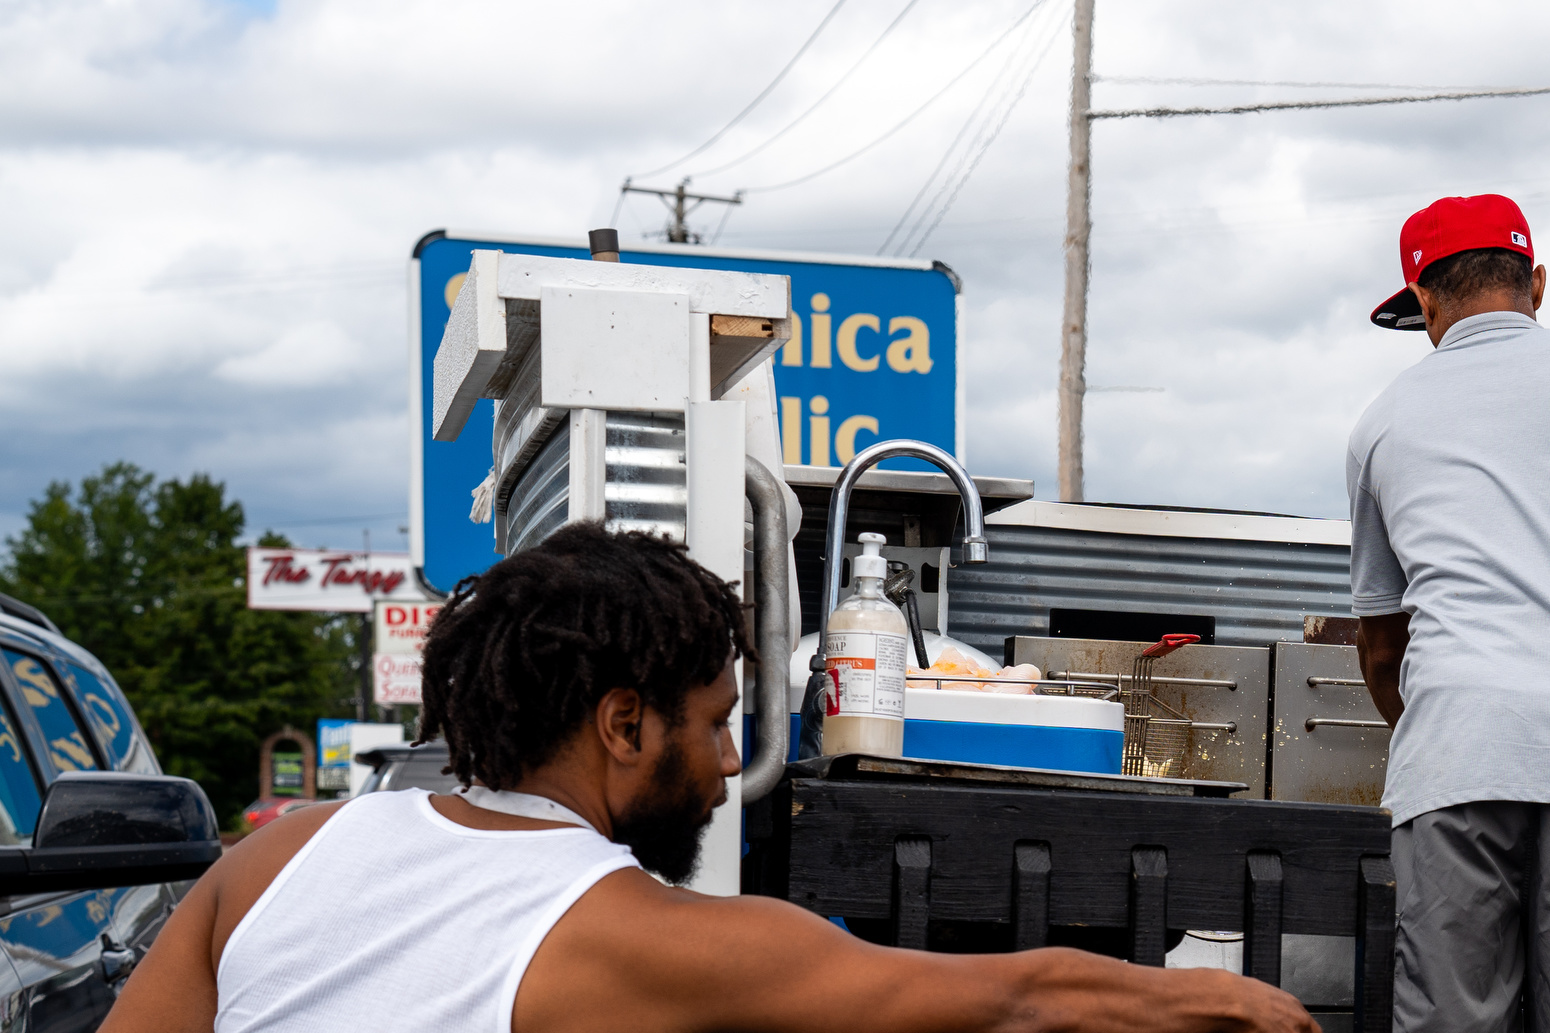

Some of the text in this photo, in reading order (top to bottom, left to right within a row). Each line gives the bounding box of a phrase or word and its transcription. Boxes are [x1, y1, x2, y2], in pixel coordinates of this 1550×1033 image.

[781, 395, 879, 469] lic
[262, 556, 310, 586] The
[385, 606, 442, 626] DIS
